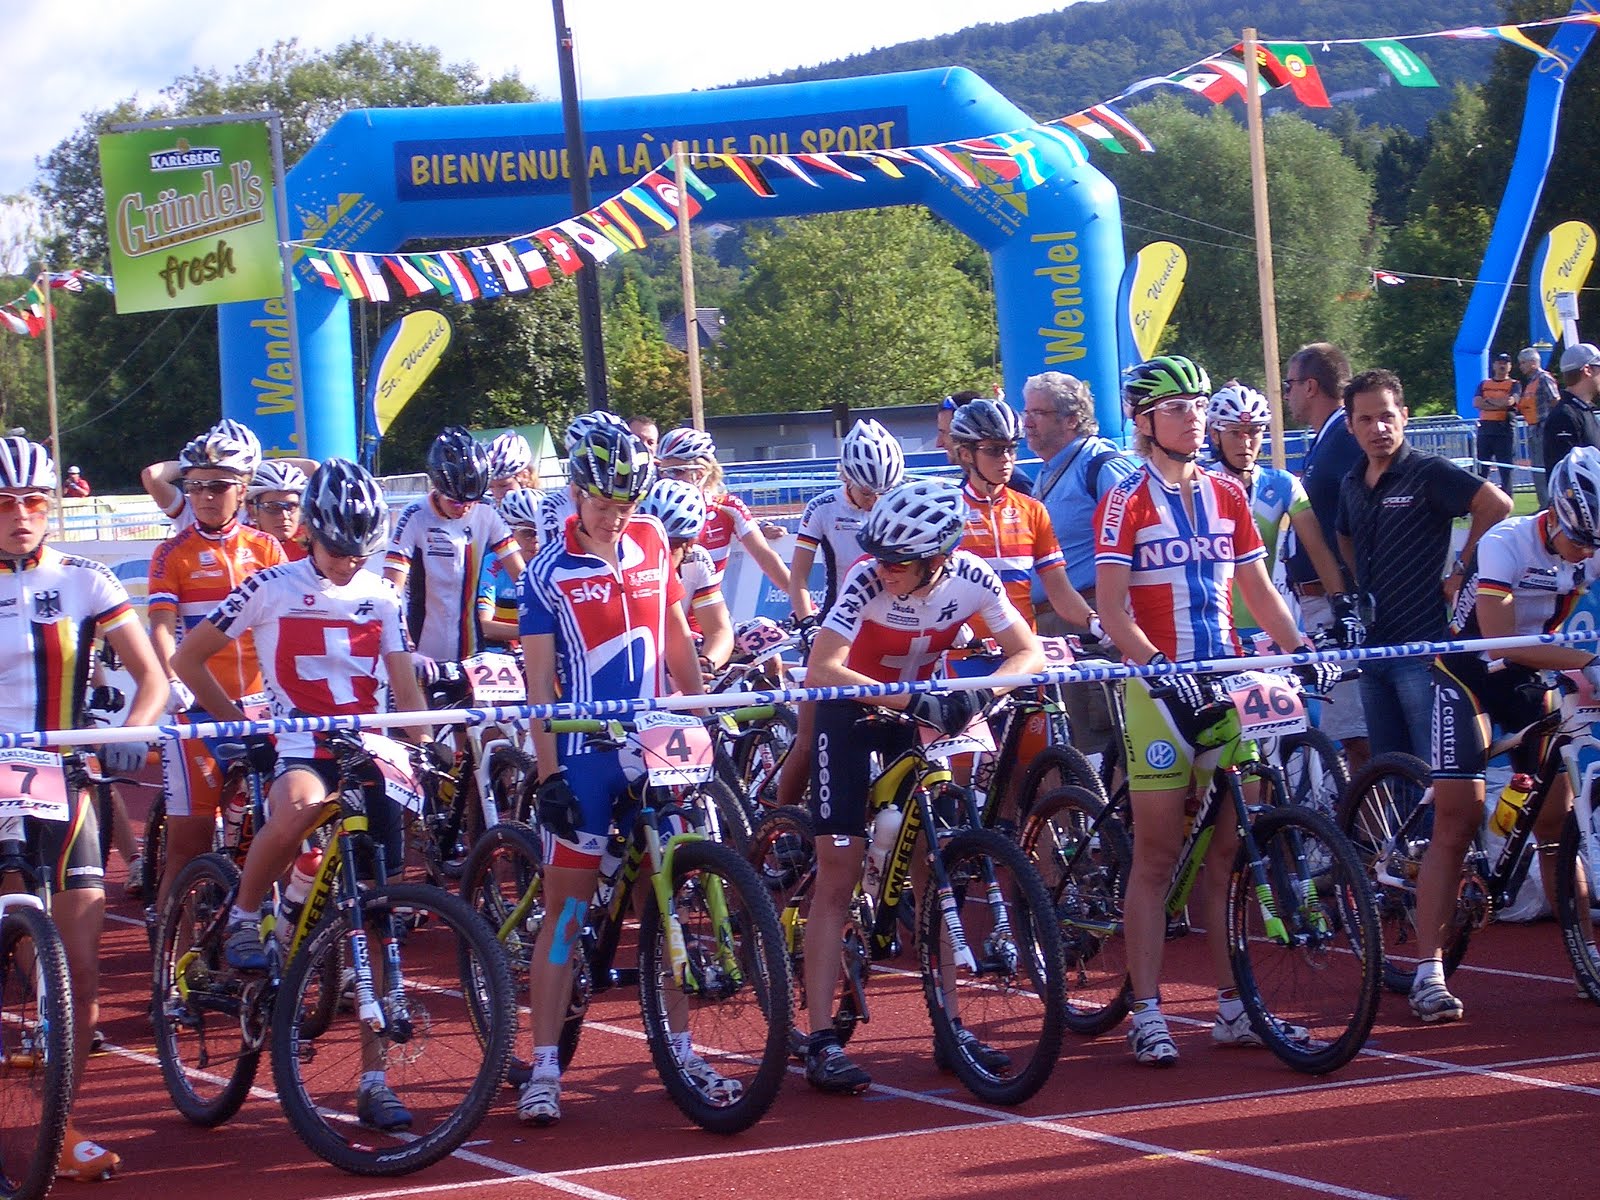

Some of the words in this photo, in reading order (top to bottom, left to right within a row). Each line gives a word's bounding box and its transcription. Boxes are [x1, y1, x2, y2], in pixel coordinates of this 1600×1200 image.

[151, 150, 221, 169] KARLSBERG
[588, 145, 608, 179] A
[800, 121, 896, 159] SPORT
[117, 160, 264, 257] Gründel's
[159, 239, 236, 298] fresh
[1558, 228, 1590, 278] Wendel
[1031, 231, 1087, 365] Wendel
[1135, 309, 1153, 331] St.
[1147, 248, 1180, 301] Wendel
[250, 298, 298, 416] Wende
[380, 376, 402, 398] St.
[401, 320, 445, 371] Wendel
[570, 581, 612, 604] sky
[744, 625, 783, 651] 33
[477, 664, 517, 686] 24
[1243, 686, 1296, 720] 46
[1245, 718, 1300, 734] STEVENS
[1442, 706, 1459, 769] central
[0, 750, 51, 761] ARLSBERG
[665, 728, 693, 763] 4
[11, 765, 38, 795] 7
[652, 766, 710, 778] STEVENS
[817, 733, 831, 819] assos
[1134, 771, 1182, 780] MERIDA
